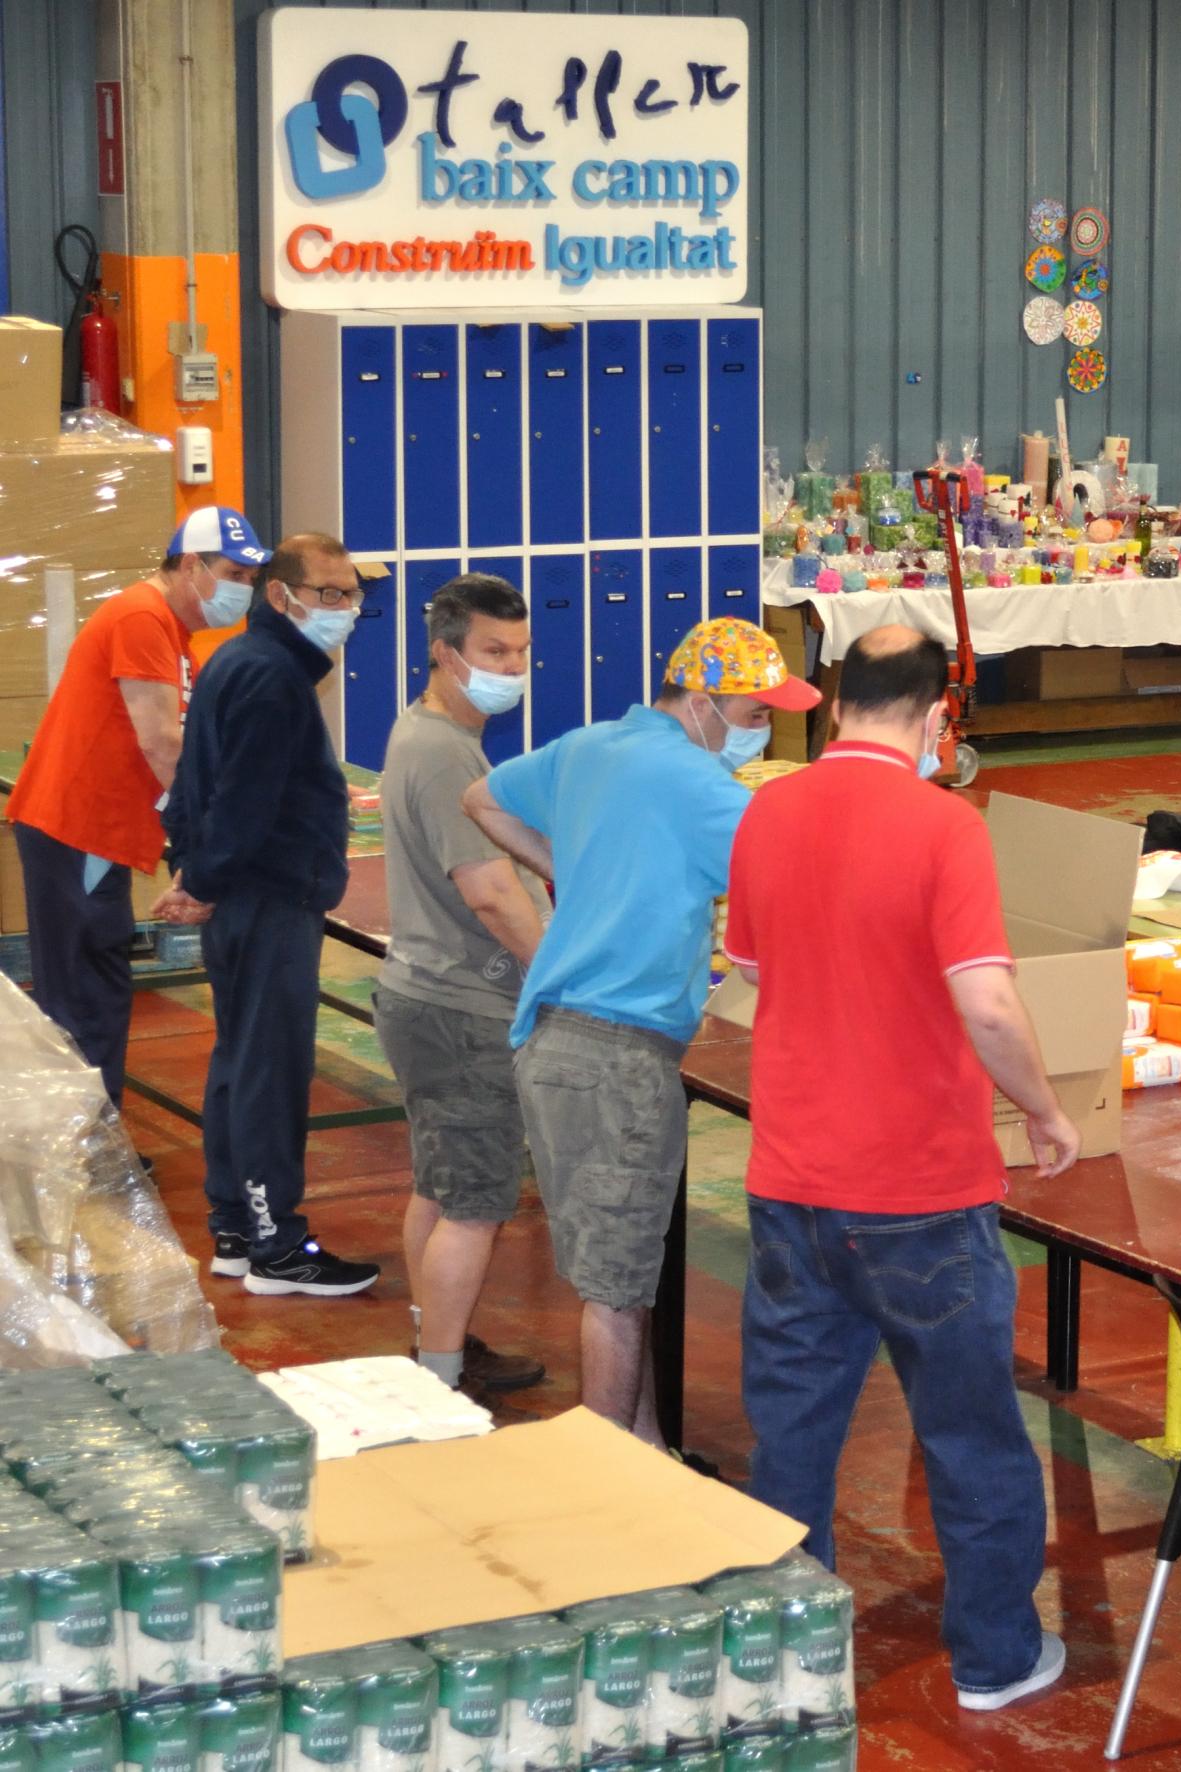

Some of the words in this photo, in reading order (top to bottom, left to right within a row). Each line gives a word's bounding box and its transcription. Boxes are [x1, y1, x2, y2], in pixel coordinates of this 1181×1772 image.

[417, 132, 556, 201] baix
[572, 158, 741, 217] camp
[286, 224, 535, 274] Construïm
[545, 221, 736, 286] Igualtat
[230, 1601, 269, 1614] LARGO
[148, 1612, 188, 1624] LARGO
[807, 1647, 841, 1661] LARGO
[738, 1656, 774, 1667] LARGO
[677, 1671, 712, 1683] LARGO
[604, 1680, 640, 1692] LARGO
[459, 1709, 496, 1721] LARGO
[387, 1724, 424, 1738] LARGO
[309, 1735, 348, 1748] LARGO
[232, 1749, 270, 1764] LARGO
